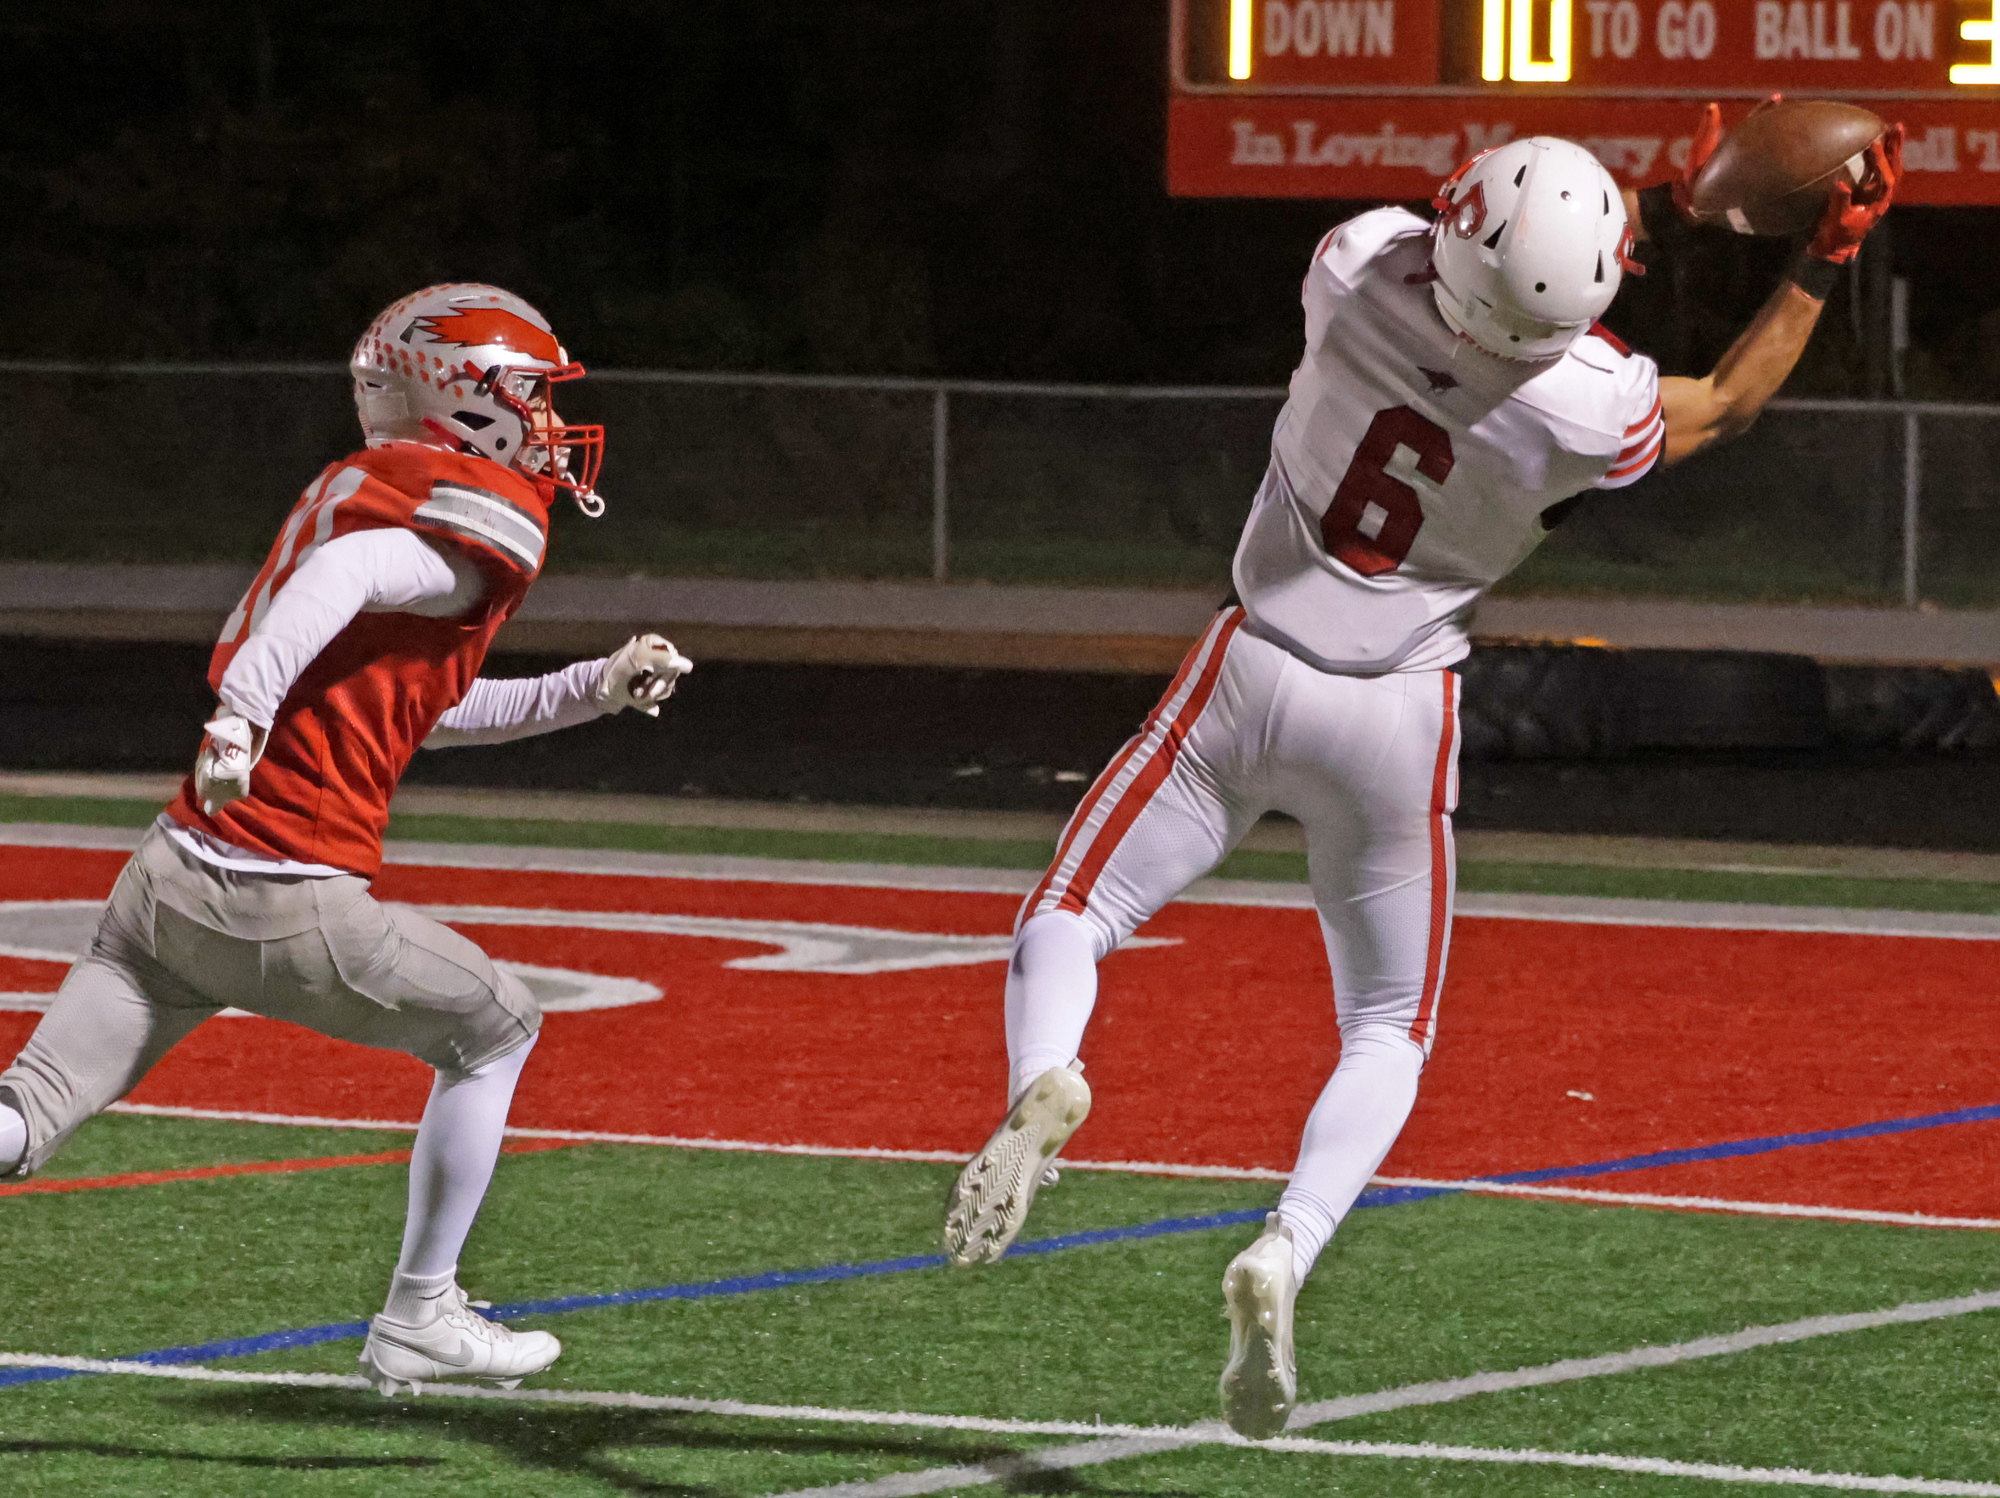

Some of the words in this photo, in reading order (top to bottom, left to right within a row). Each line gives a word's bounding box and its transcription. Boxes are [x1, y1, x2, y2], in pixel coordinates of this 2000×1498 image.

[1264, 2, 1394, 57] DOWN
[1482, 0, 1572, 82] 10
[1587, 2, 1640, 58] TO
[1657, 2, 1717, 59] GO
[1755, 2, 1861, 60] BALL
[1875, 3, 1934, 60] ON
[1231, 121, 1284, 165] In
[1293, 121, 1457, 175] Loving
[1320, 404, 1455, 577] 6
